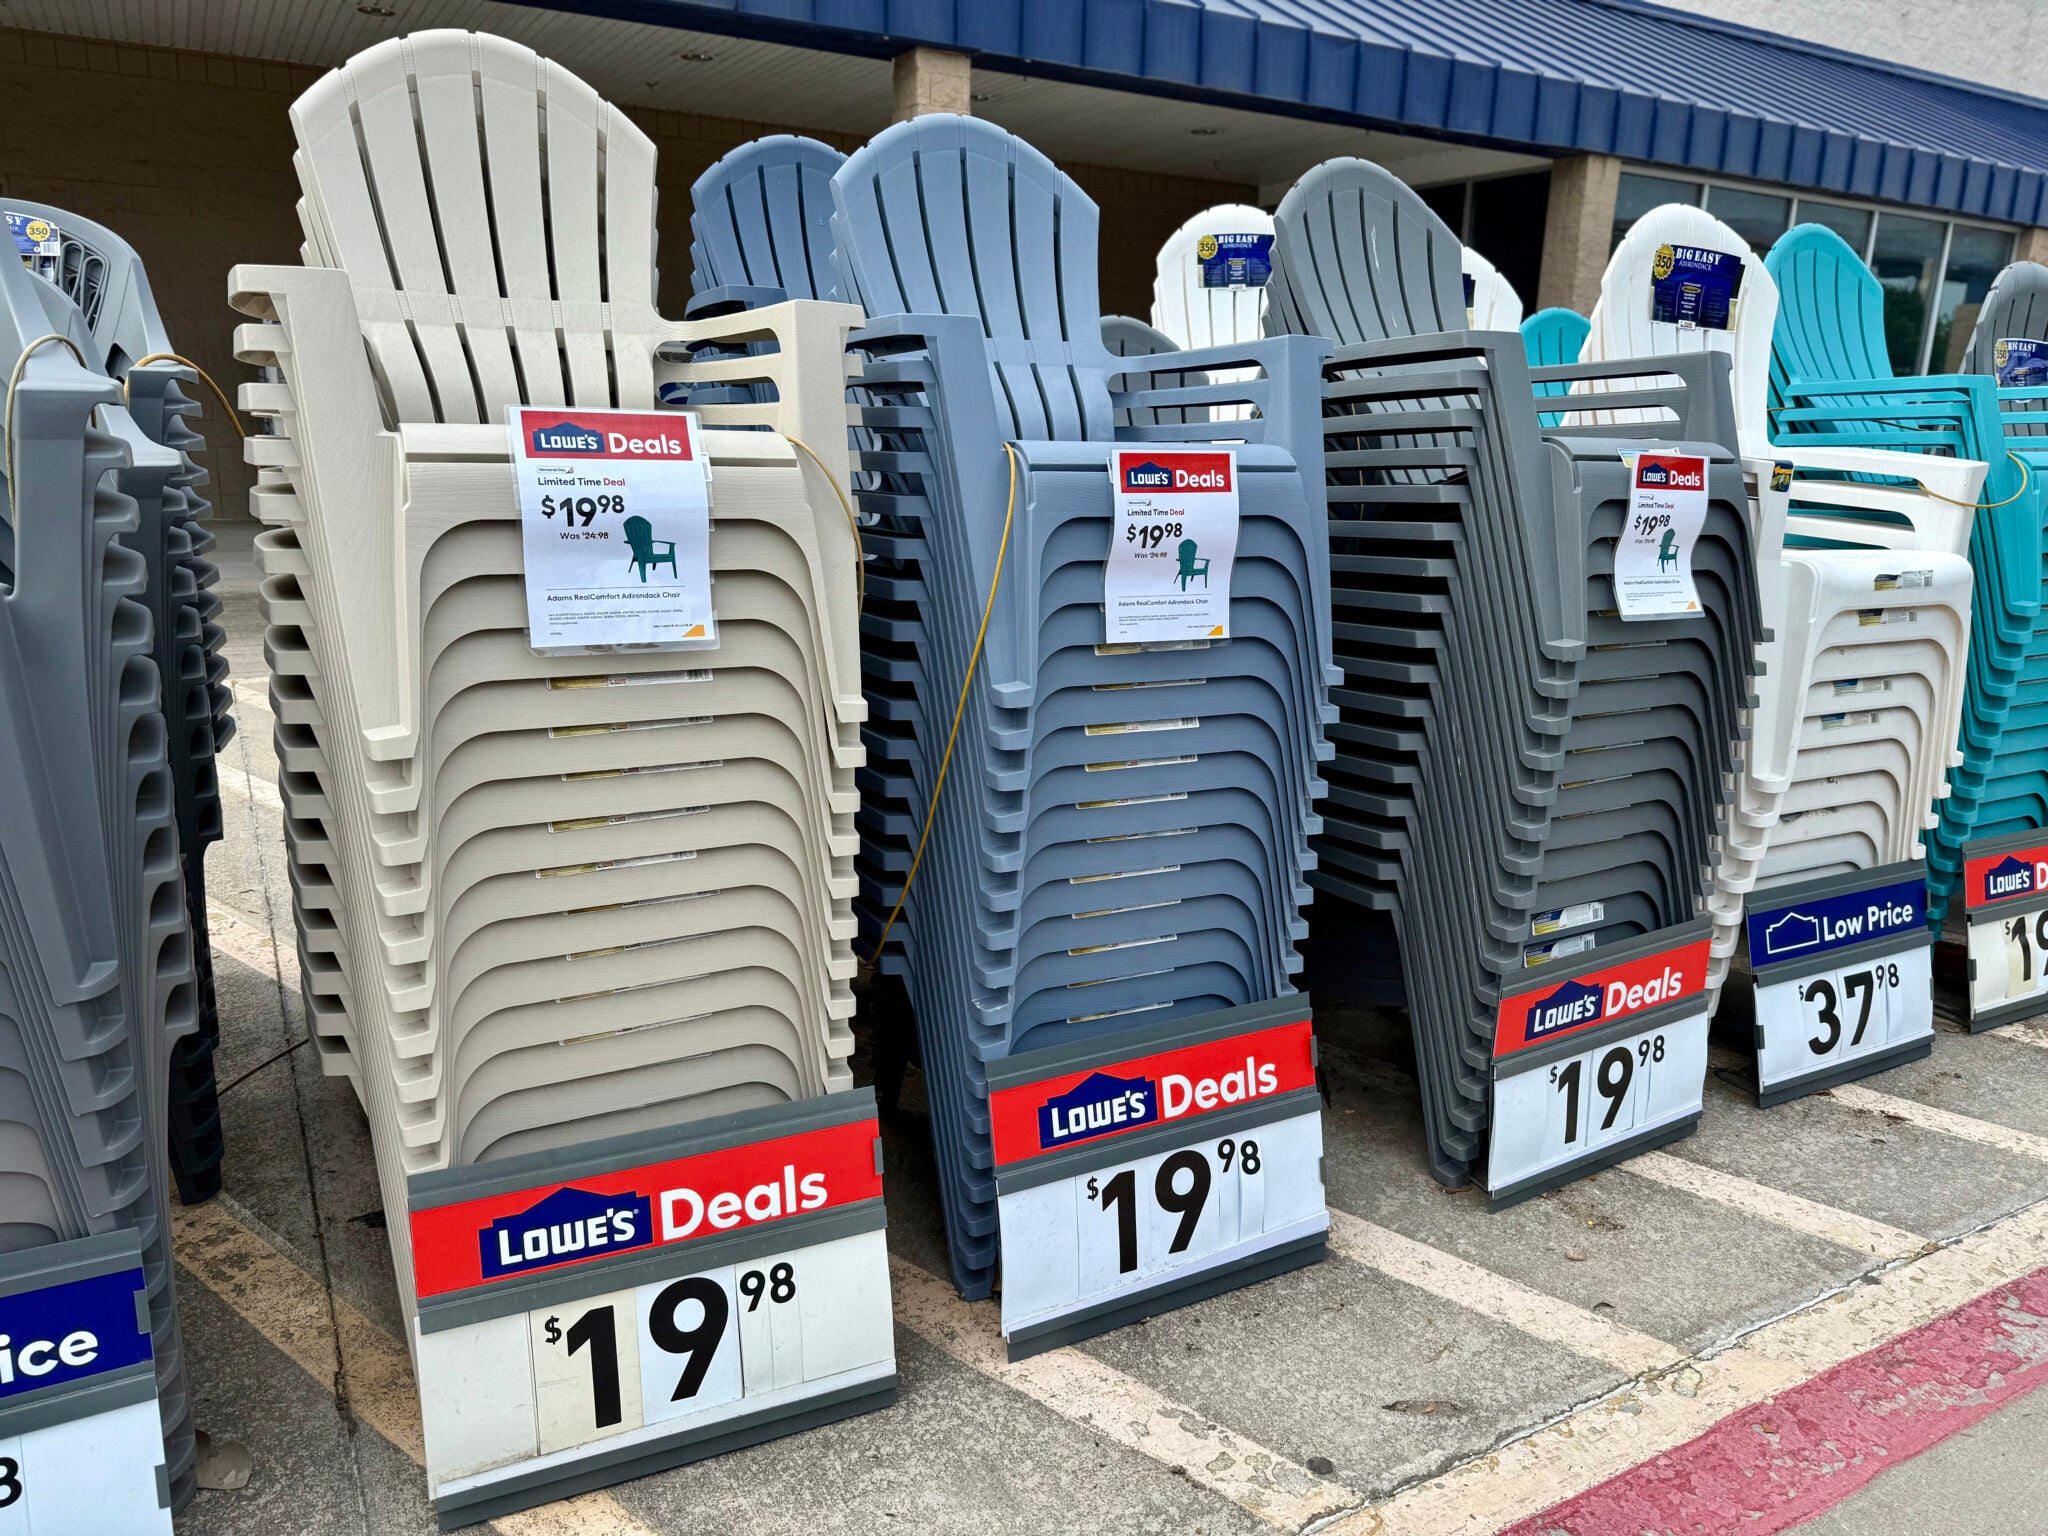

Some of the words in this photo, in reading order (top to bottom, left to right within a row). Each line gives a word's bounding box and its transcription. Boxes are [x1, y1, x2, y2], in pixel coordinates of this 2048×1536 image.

[1199, 243, 1216, 252] 350
[1218, 235, 1234, 244] BIG
[1236, 235, 1259, 244] EASY
[1655, 255, 1672, 269] 350
[1676, 248, 1694, 260] BIG
[1694, 250, 1722, 265] EASY
[2019, 342, 2037, 352] EASY
[540, 433, 599, 450] LOWE'S
[608, 432, 682, 455] Deals
[538, 477, 575, 486] Limited
[577, 477, 601, 486] Time
[604, 478, 625, 486] Deal
[1131, 472, 1169, 485] LOWE'S
[1175, 469, 1224, 488] Deals
[1643, 470, 1667, 482] LOWE'S
[1670, 470, 1700, 487] Deals
[1170, 508, 1184, 516] Deal
[560, 532, 580, 540] Was
[1989, 869, 2030, 895] LOWE'S
[1823, 915, 1862, 942] Low
[1867, 902, 1913, 931] Price
[1533, 995, 1597, 1033] LOWE'S
[1606, 967, 1683, 1016] Deals
[1051, 1090, 1147, 1139] LOWE'S
[1161, 1056, 1278, 1119] Deals
[499, 1208, 637, 1266] LOWE'S
[659, 1165, 828, 1241] Deals
